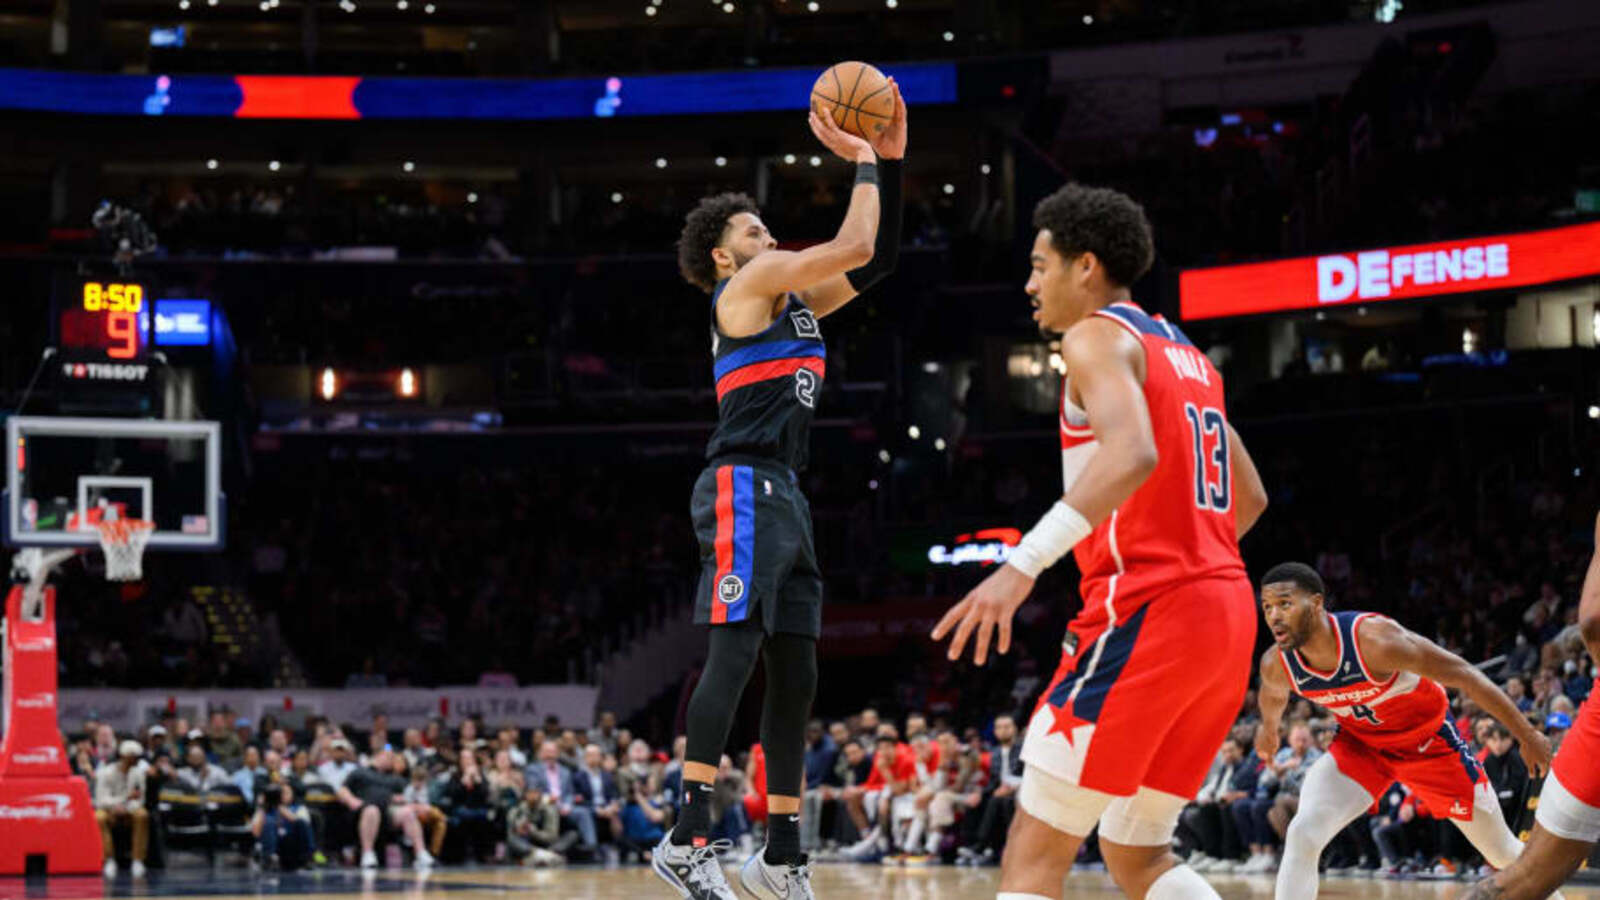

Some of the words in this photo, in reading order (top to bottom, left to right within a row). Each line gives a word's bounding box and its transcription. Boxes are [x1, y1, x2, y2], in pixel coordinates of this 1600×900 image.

[1317, 243, 1509, 304] DEFENSE
[83, 282, 143, 313] 8:50
[106, 312, 137, 359] 9
[87, 363, 148, 380] TISSOT
[795, 367, 815, 409] 2
[1184, 402, 1230, 513] 13
[455, 698, 538, 716] ULTRA
[1352, 704, 1384, 725] 4
